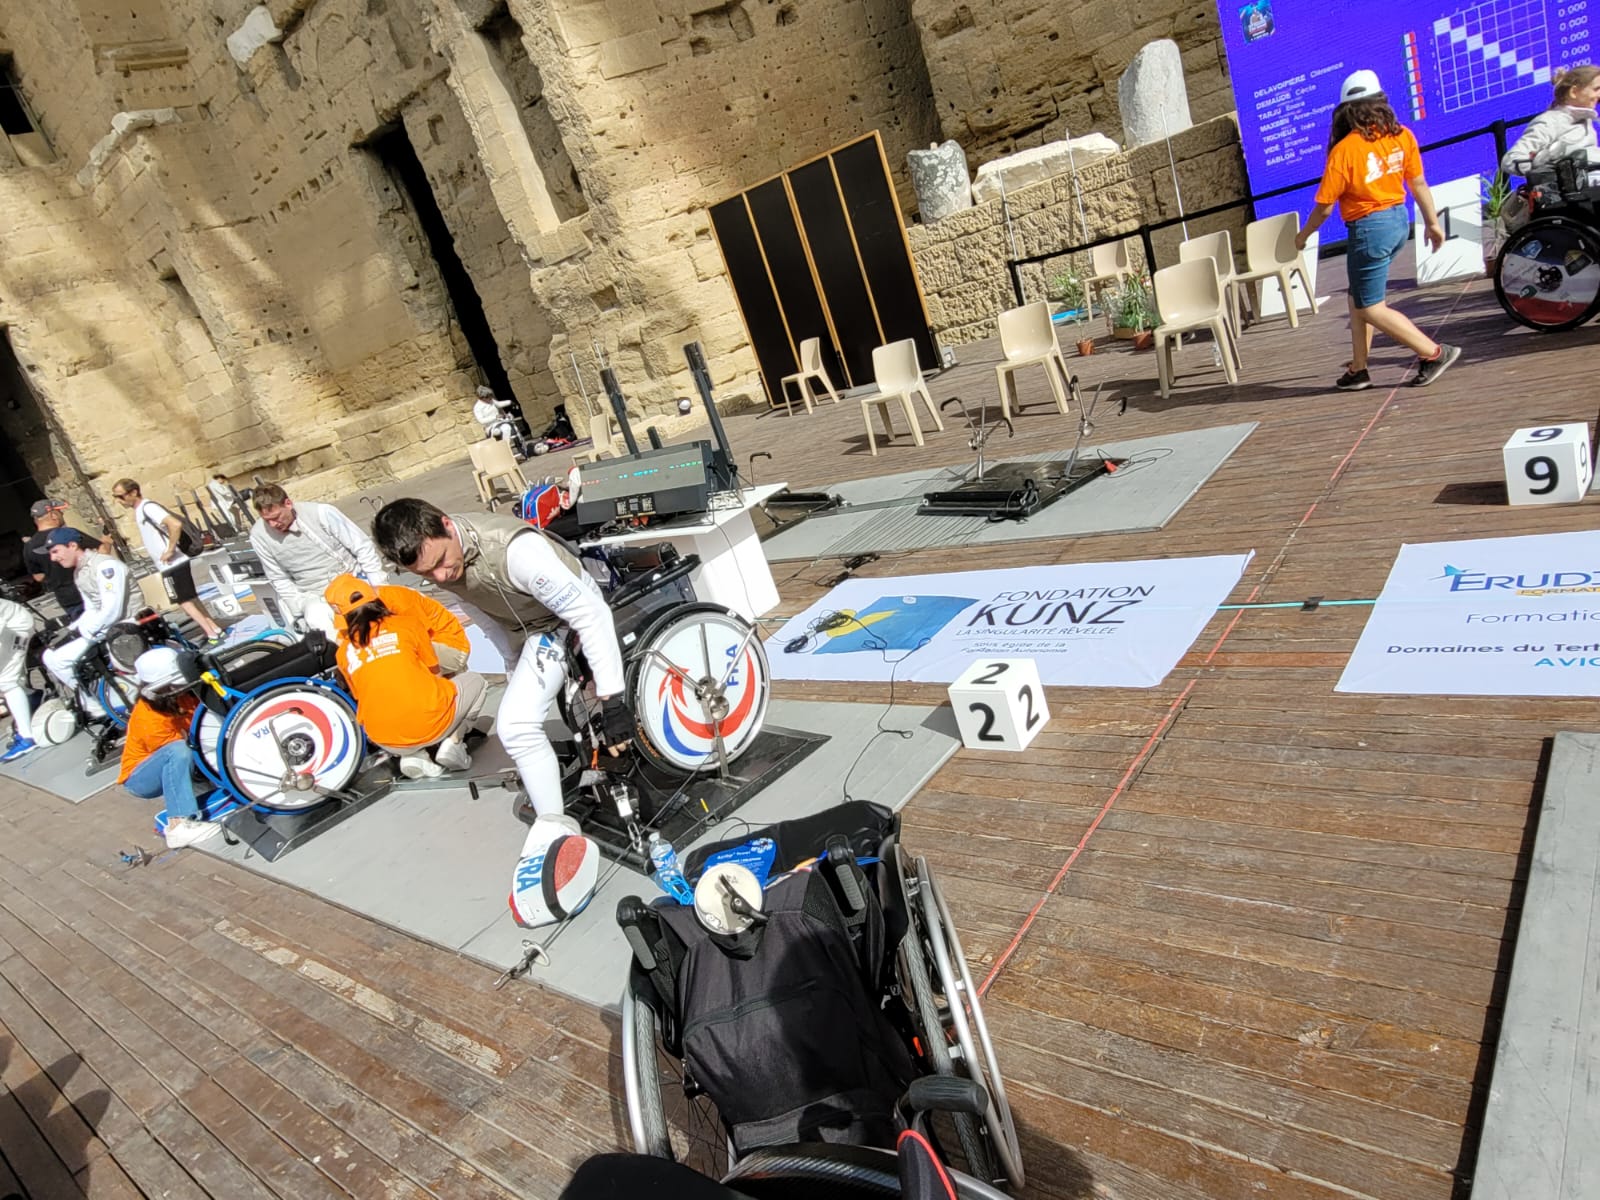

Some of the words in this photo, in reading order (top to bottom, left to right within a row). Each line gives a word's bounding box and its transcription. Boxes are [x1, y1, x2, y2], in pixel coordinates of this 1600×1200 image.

[1525, 428, 1564, 443] 9
[1580, 441, 1588, 484] 9
[1525, 456, 1559, 495] 9
[992, 585, 1156, 602] FONDATION
[222, 600, 234, 612] 5
[967, 600, 1143, 626] KUNZ
[974, 626, 1059, 636] SINGULARITÉ
[1060, 626, 1119, 635] RÉVÉLÉE
[1386, 644, 1504, 654] Domaines
[1513, 644, 1545, 652] du
[970, 662, 1010, 684] 2
[1018, 684, 1040, 732] 2
[969, 702, 1005, 742] 2
[516, 854, 545, 894] FRA
